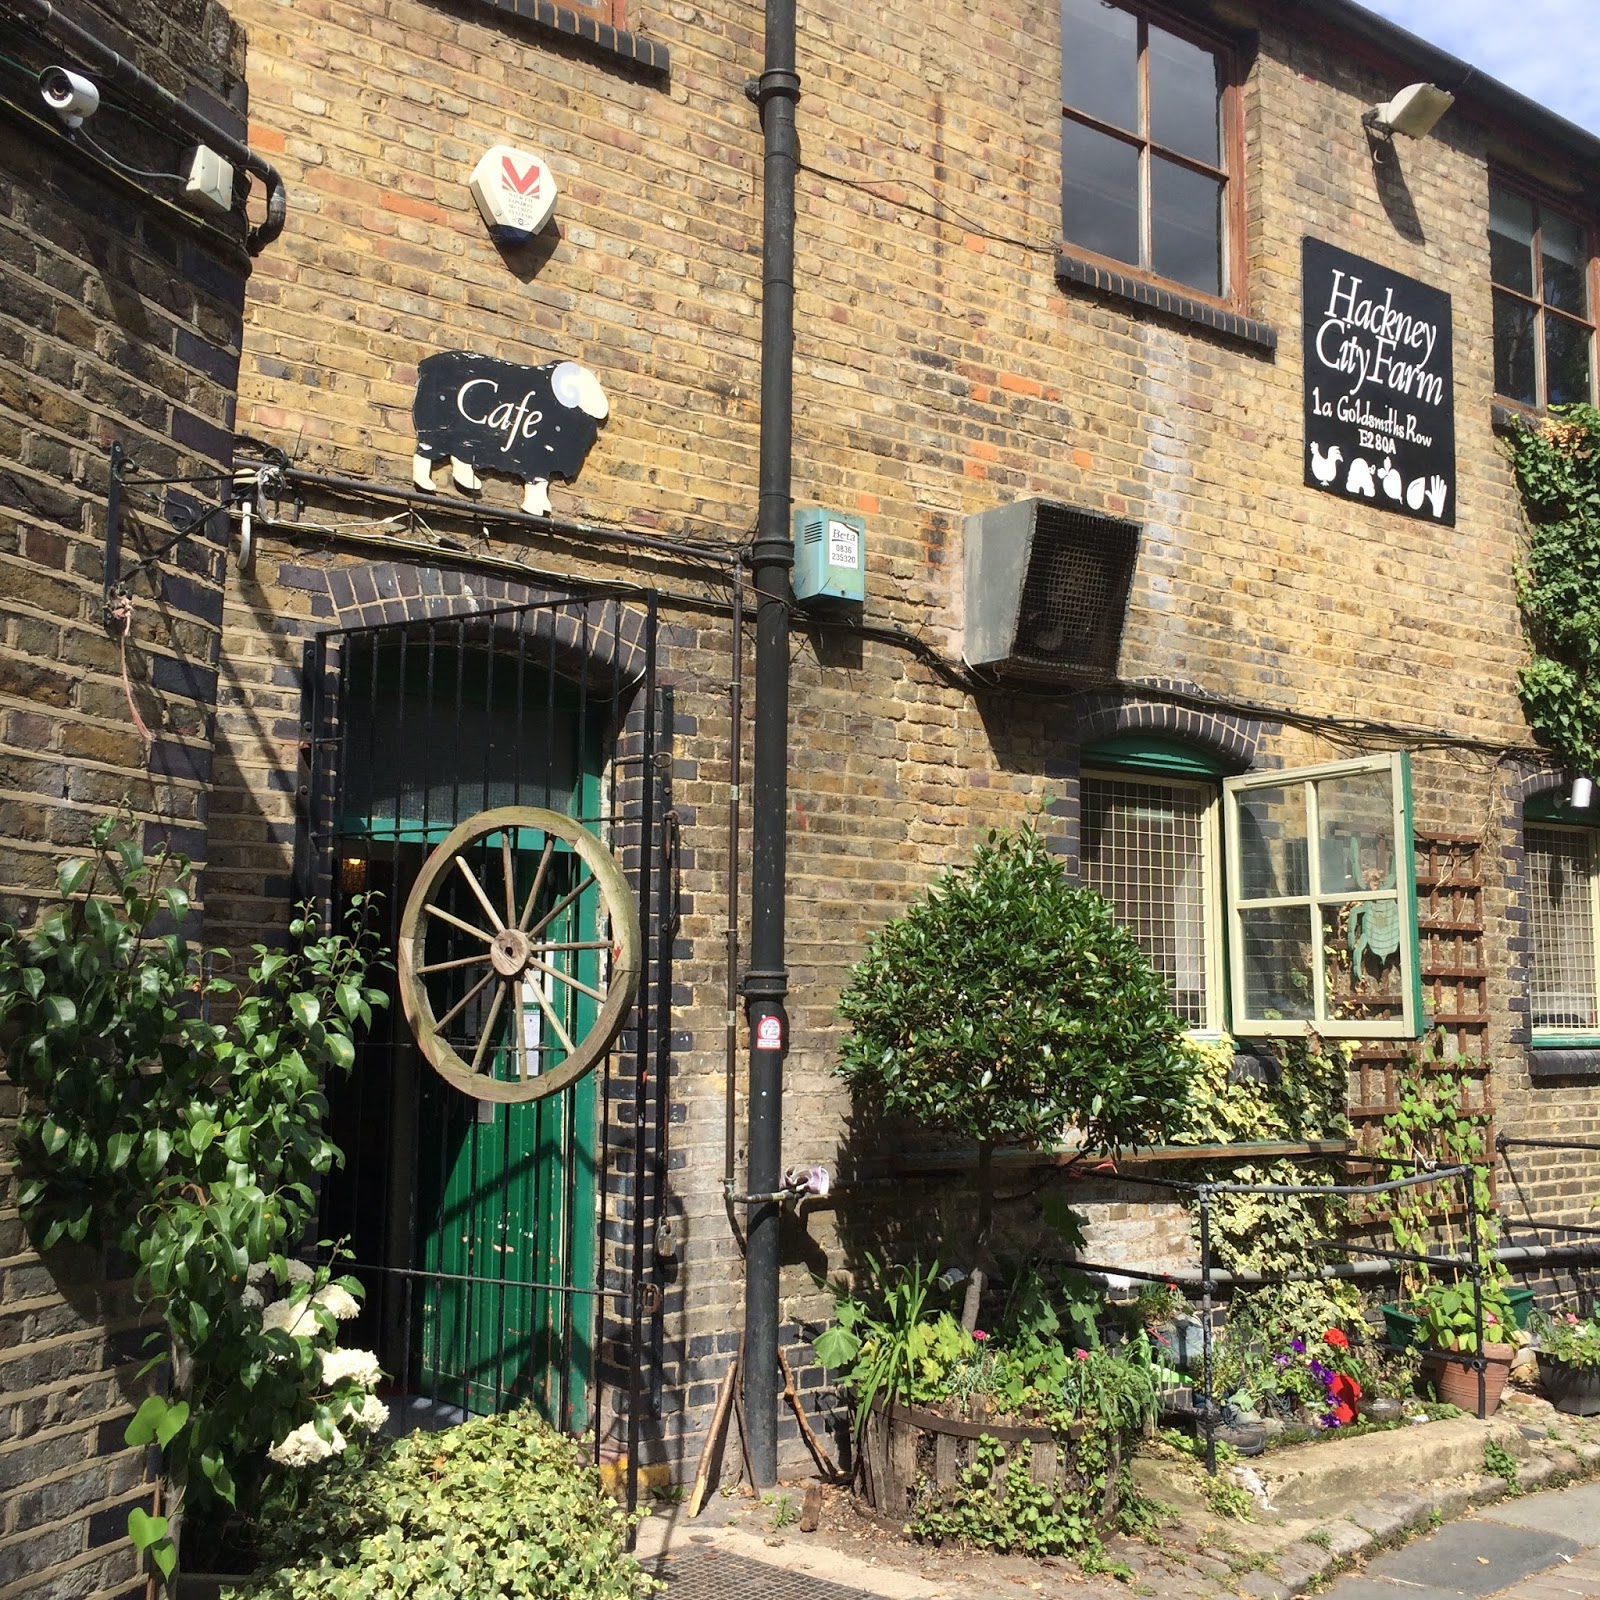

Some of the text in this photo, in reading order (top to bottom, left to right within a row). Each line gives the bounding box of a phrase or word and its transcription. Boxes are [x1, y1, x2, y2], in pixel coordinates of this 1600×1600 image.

[1324, 268, 1437, 369] Hackney
[1316, 318, 1443, 406] City Farm
[457, 379, 543, 452] Cafe
[1312, 386, 1432, 447] 1a Goldsmiths Row
[832, 528, 856, 542] Beta
[832, 552, 856, 564] 235320
[835, 544, 852, 554] 0836
